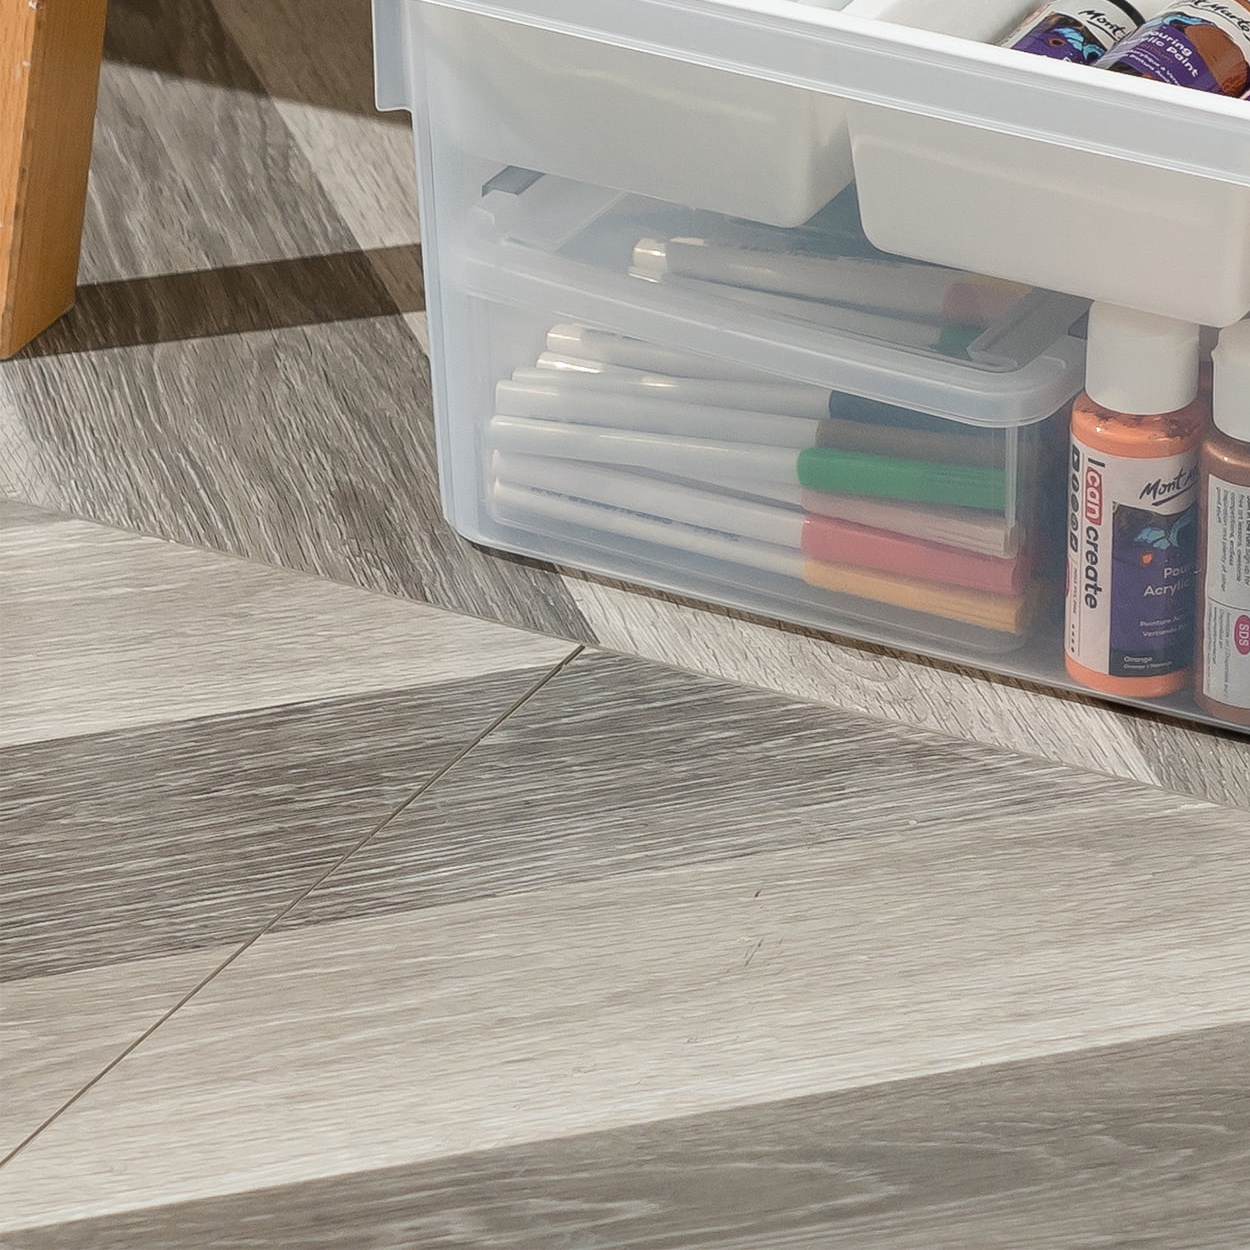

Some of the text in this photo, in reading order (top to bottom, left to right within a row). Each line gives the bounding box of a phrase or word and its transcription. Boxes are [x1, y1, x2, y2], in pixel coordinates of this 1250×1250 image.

[1078, 10, 1127, 40] Mont
[1149, 30, 1193, 57] ouring
[1166, 46, 1199, 78] Paint
[1139, 467, 1187, 500] Mont
[1085, 457, 1106, 610] I can create
[1238, 623, 1250, 648] SDS
